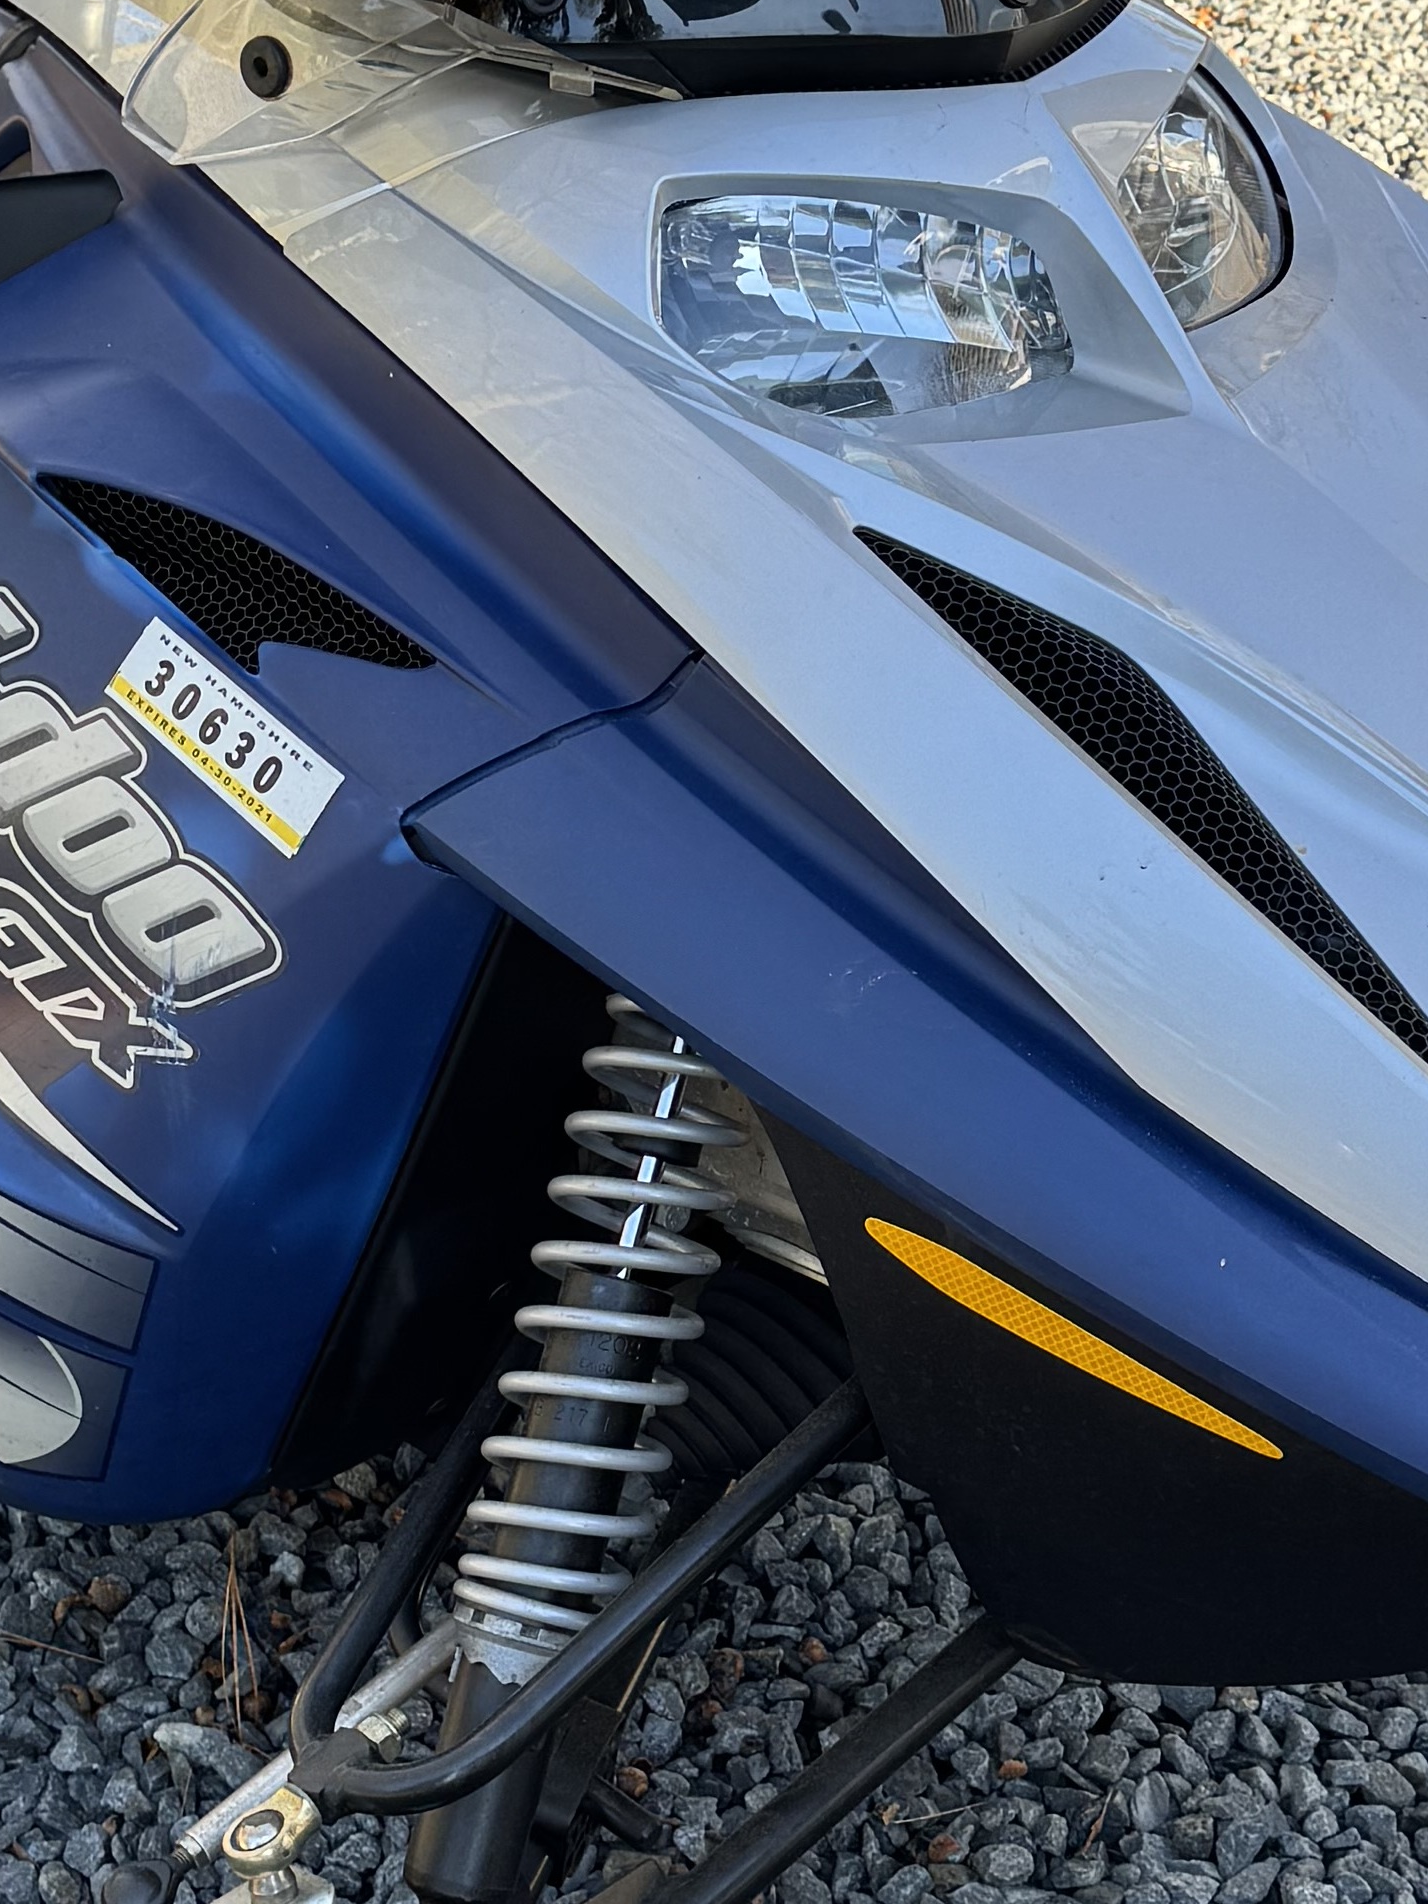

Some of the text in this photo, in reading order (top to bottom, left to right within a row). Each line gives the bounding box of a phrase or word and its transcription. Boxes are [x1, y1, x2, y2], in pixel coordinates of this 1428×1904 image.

[126, 688, 273, 823] EXPIRES 04-30-2021
[144, 660, 283, 794] 30630
[159, 634, 313, 772] NEW HAMPSHIRE
